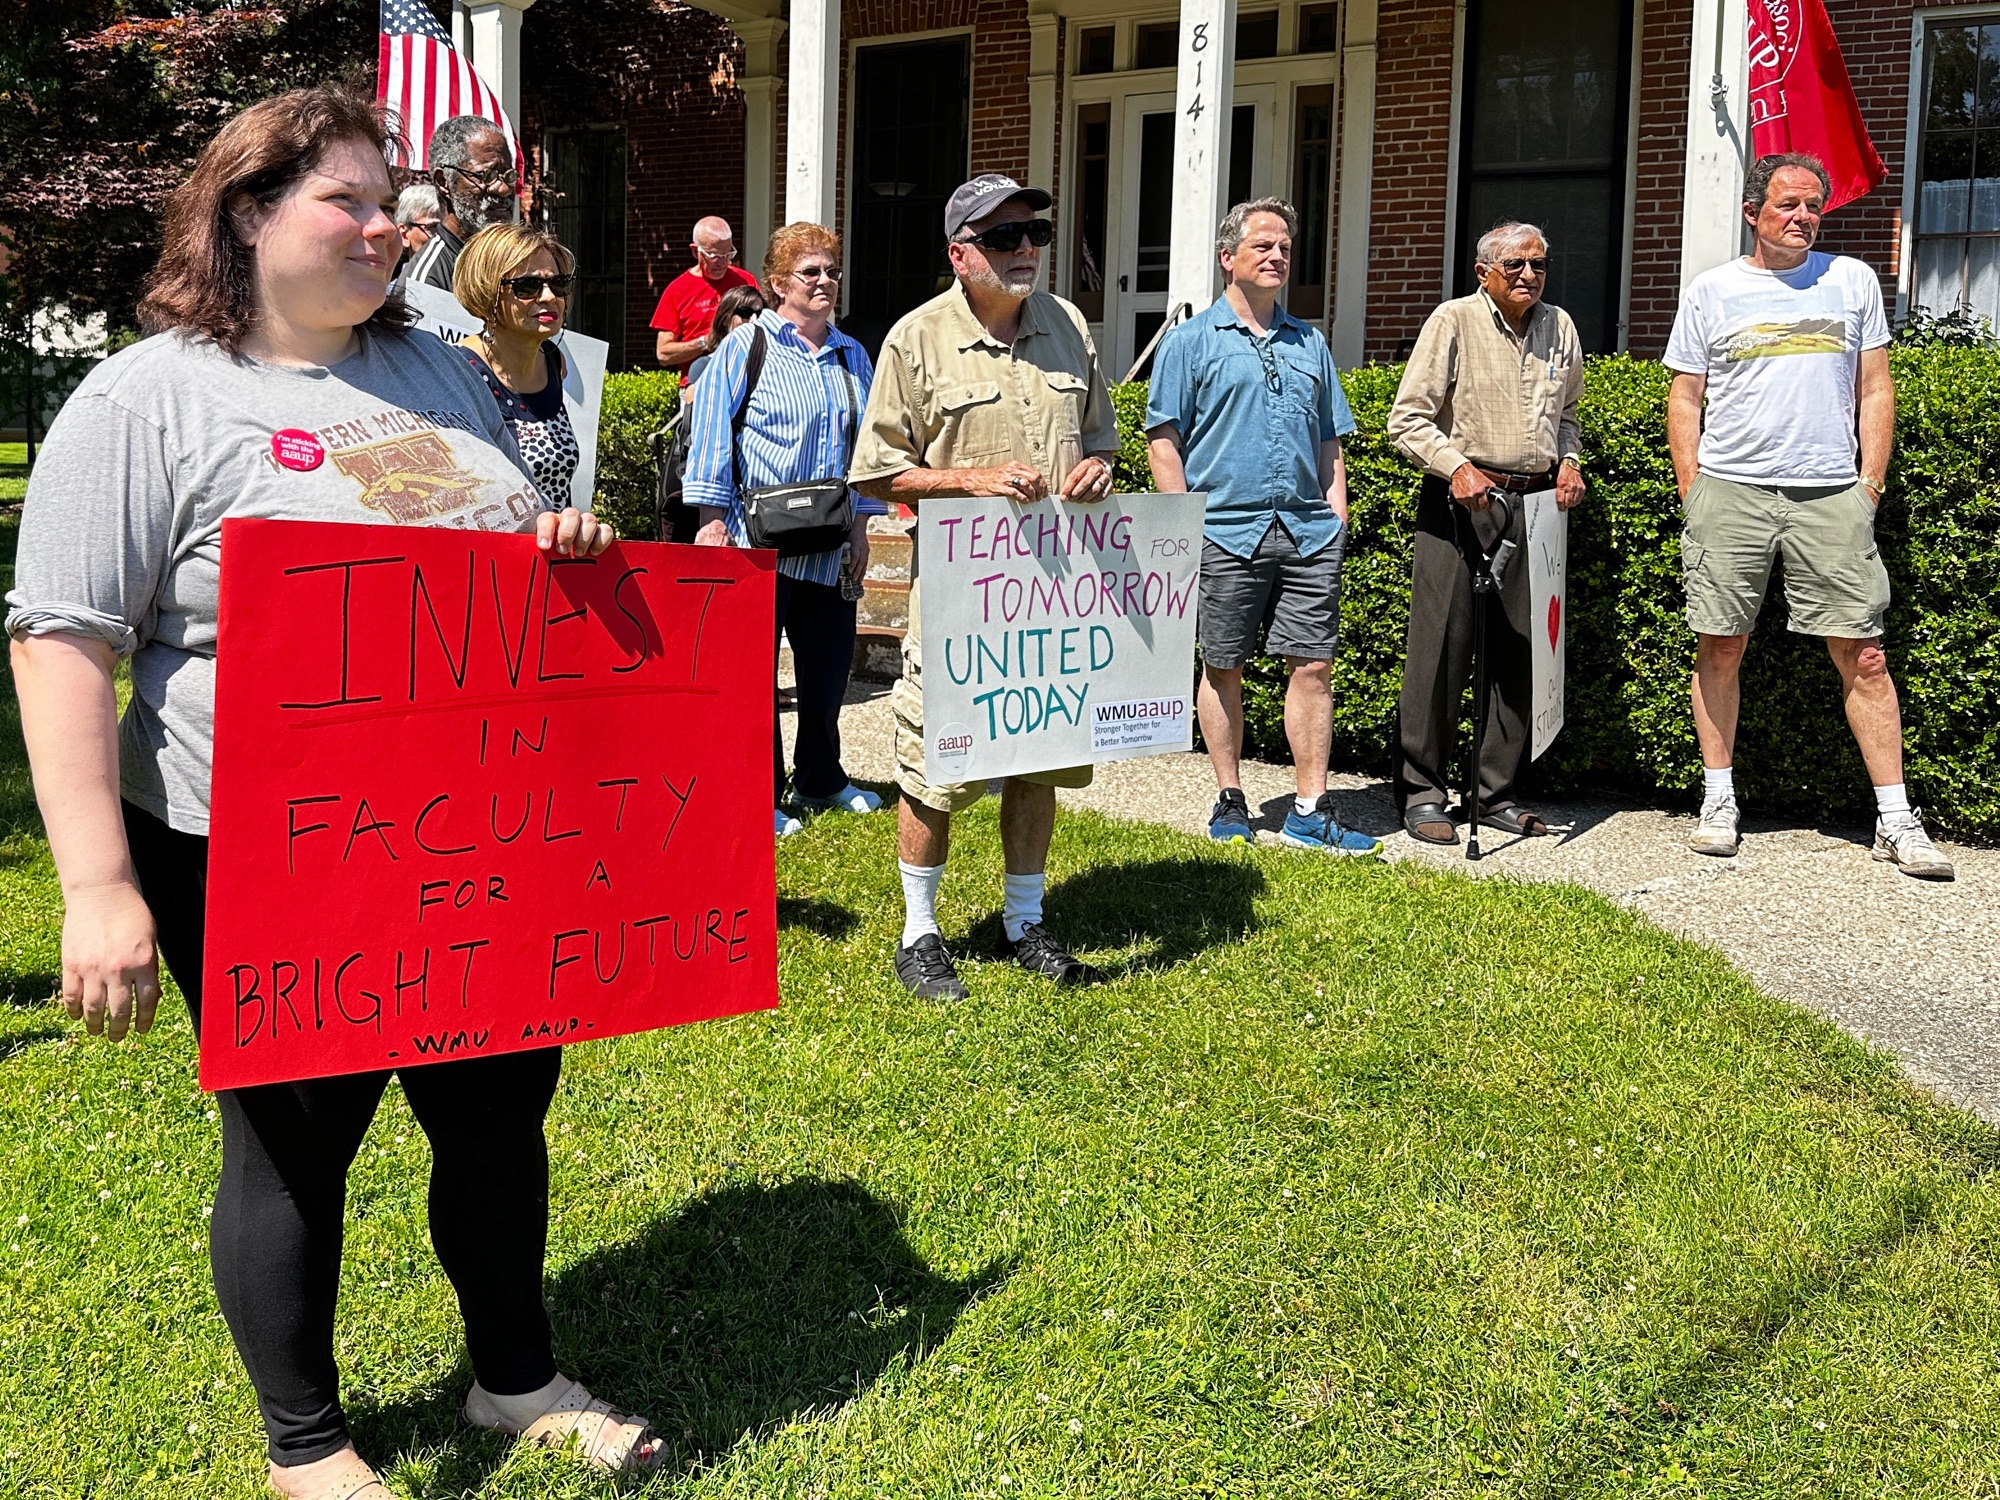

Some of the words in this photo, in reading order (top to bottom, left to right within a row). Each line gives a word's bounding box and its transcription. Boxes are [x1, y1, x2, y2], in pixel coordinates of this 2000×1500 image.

[1187, 22, 1209, 122] 814
[281, 443, 299, 451] with
[300, 445, 314, 454] the
[291, 438, 321, 450] sticking
[373, 409, 479, 438] MICHIGAN
[281, 450, 315, 467] aaup
[938, 511, 1133, 563] TEACHING
[1150, 538, 1190, 559] FOR
[973, 571, 1199, 623] TOMORROW
[279, 549, 736, 709] INVEST
[945, 625, 1114, 686] UNITED
[973, 682, 1089, 741] TODAY
[1094, 724, 1121, 735] Stronger
[1122, 721, 1150, 732] Together
[1151, 720, 1161, 728] for
[1096, 699, 1184, 721] WMUaaup
[480, 716, 549, 765] IN
[938, 734, 973, 755] aaup
[1100, 737, 1120, 747] Better
[1121, 735, 1153, 744] Tomorrow
[287, 775, 697, 874] FACULTY
[419, 875, 510, 923] FOR
[585, 860, 612, 891] A
[225, 938, 491, 1048] BRIGHT
[550, 908, 750, 1000] FUTURE
